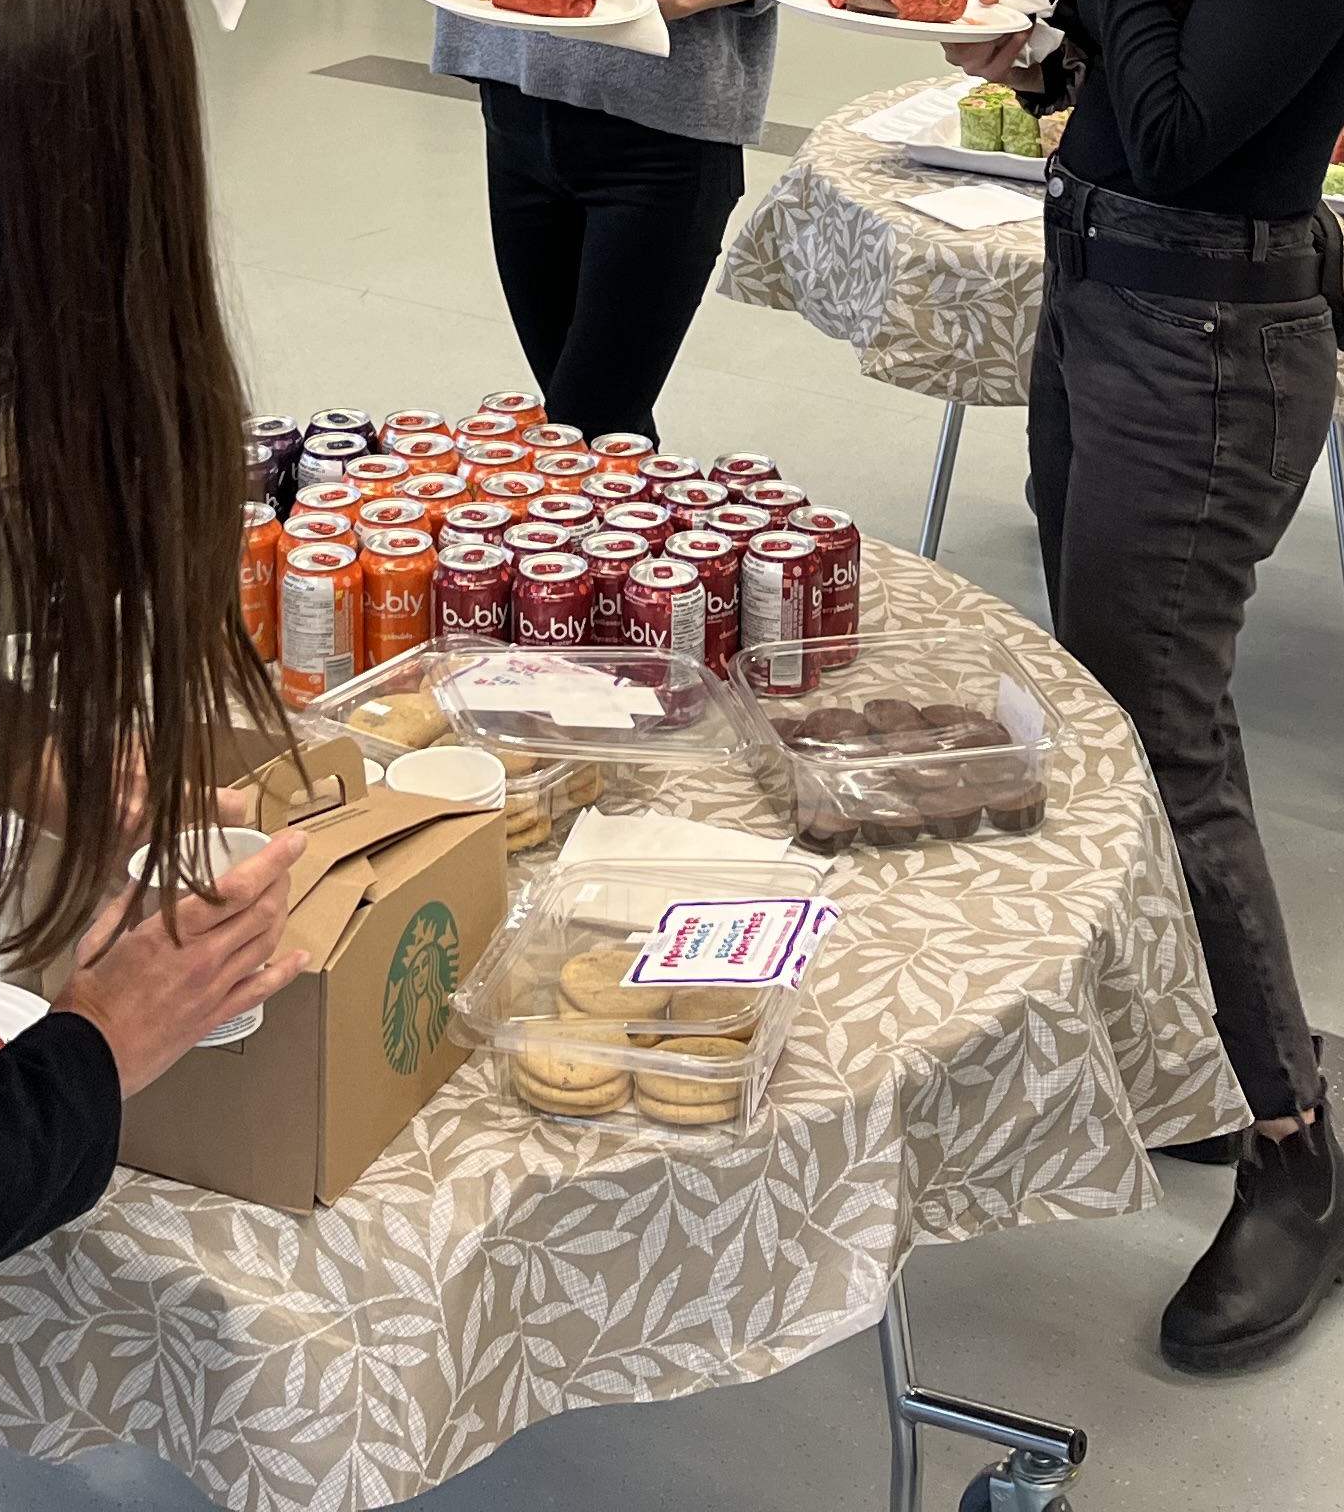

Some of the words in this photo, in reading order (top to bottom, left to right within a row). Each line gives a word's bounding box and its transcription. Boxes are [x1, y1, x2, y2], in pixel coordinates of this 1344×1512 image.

[442, 601, 509, 629] bubly
[520, 612, 587, 644] bubly
[660, 916, 701, 967] MONSTER
[685, 922, 714, 960] COOKIES
[728, 911, 766, 965] MONSTRES
